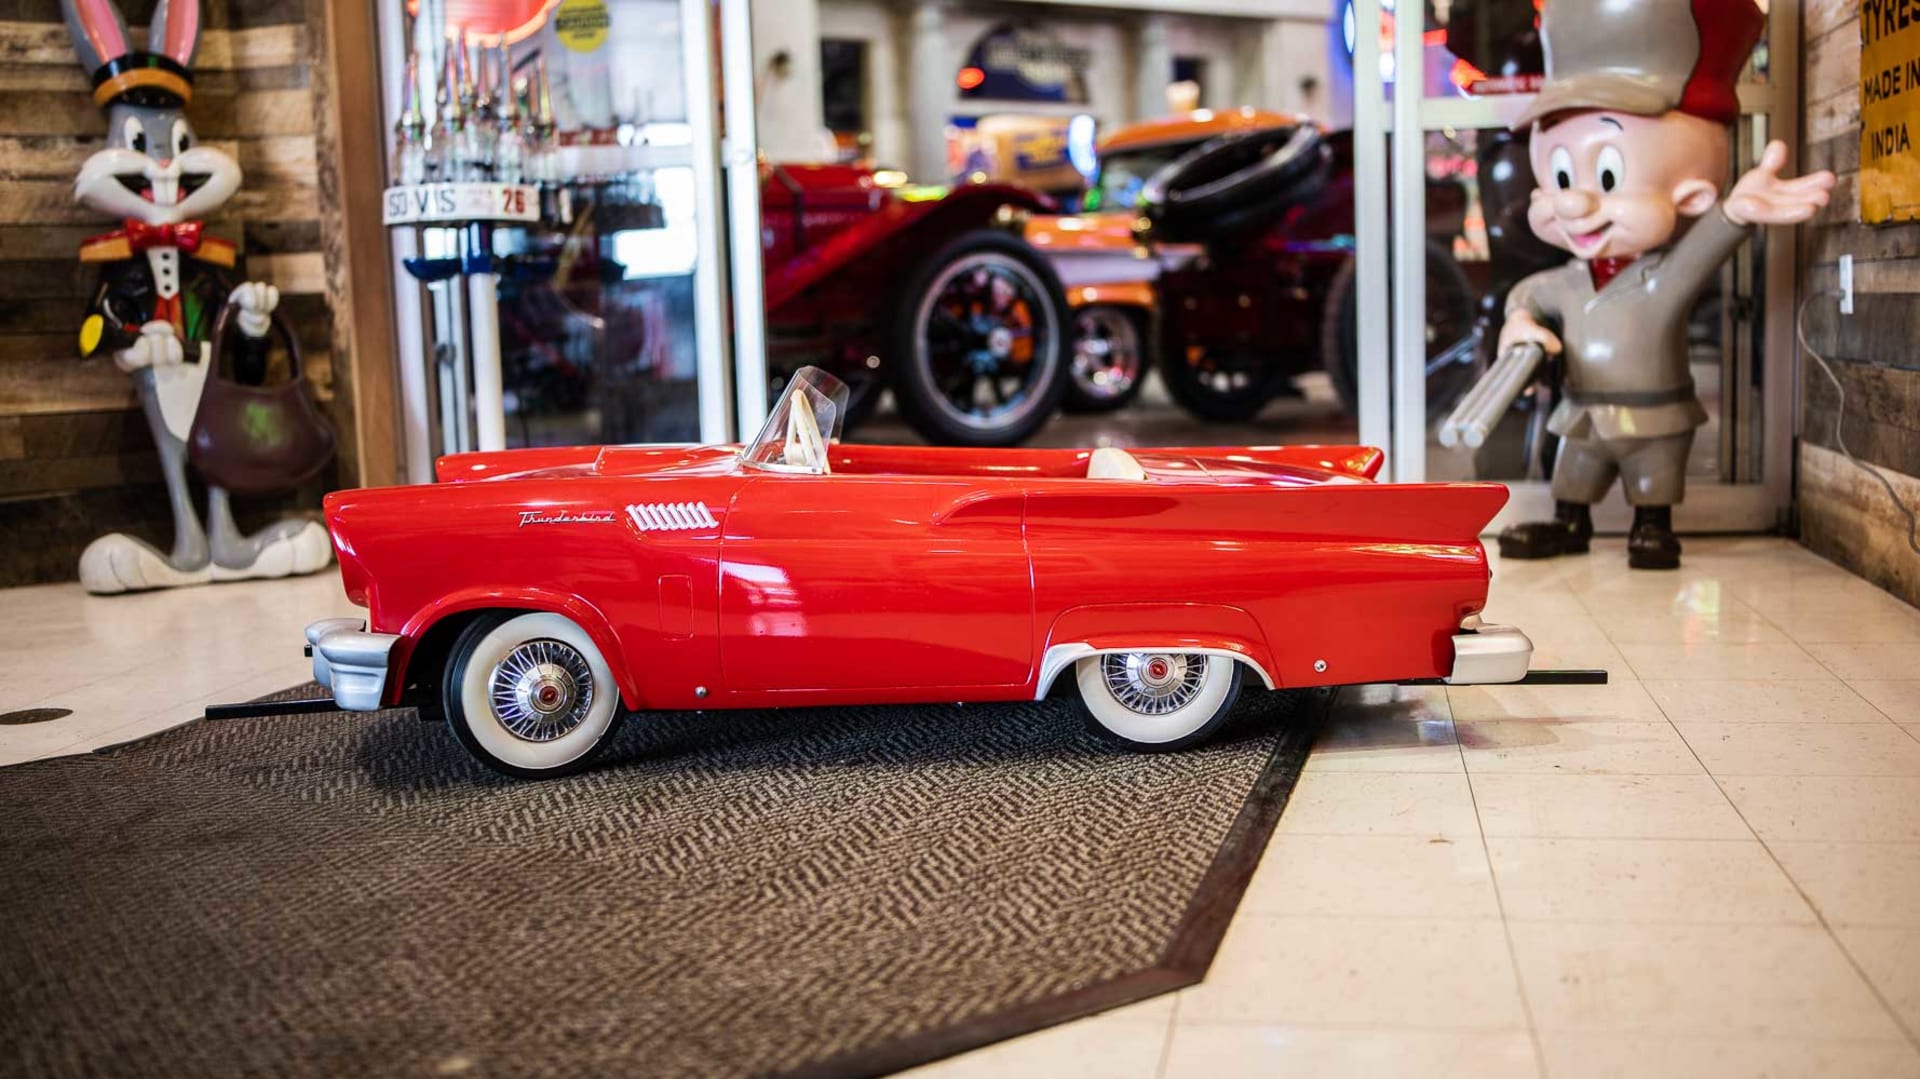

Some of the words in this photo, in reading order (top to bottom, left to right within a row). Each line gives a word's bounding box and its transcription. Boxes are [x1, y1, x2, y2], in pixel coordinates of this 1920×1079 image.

[1864, 64, 1901, 106] MADE
[1905, 56, 1920, 91] IN
[1871, 122, 1911, 161] INDIA
[503, 188, 525, 214] 26
[518, 510, 617, 528] Thunderbird
